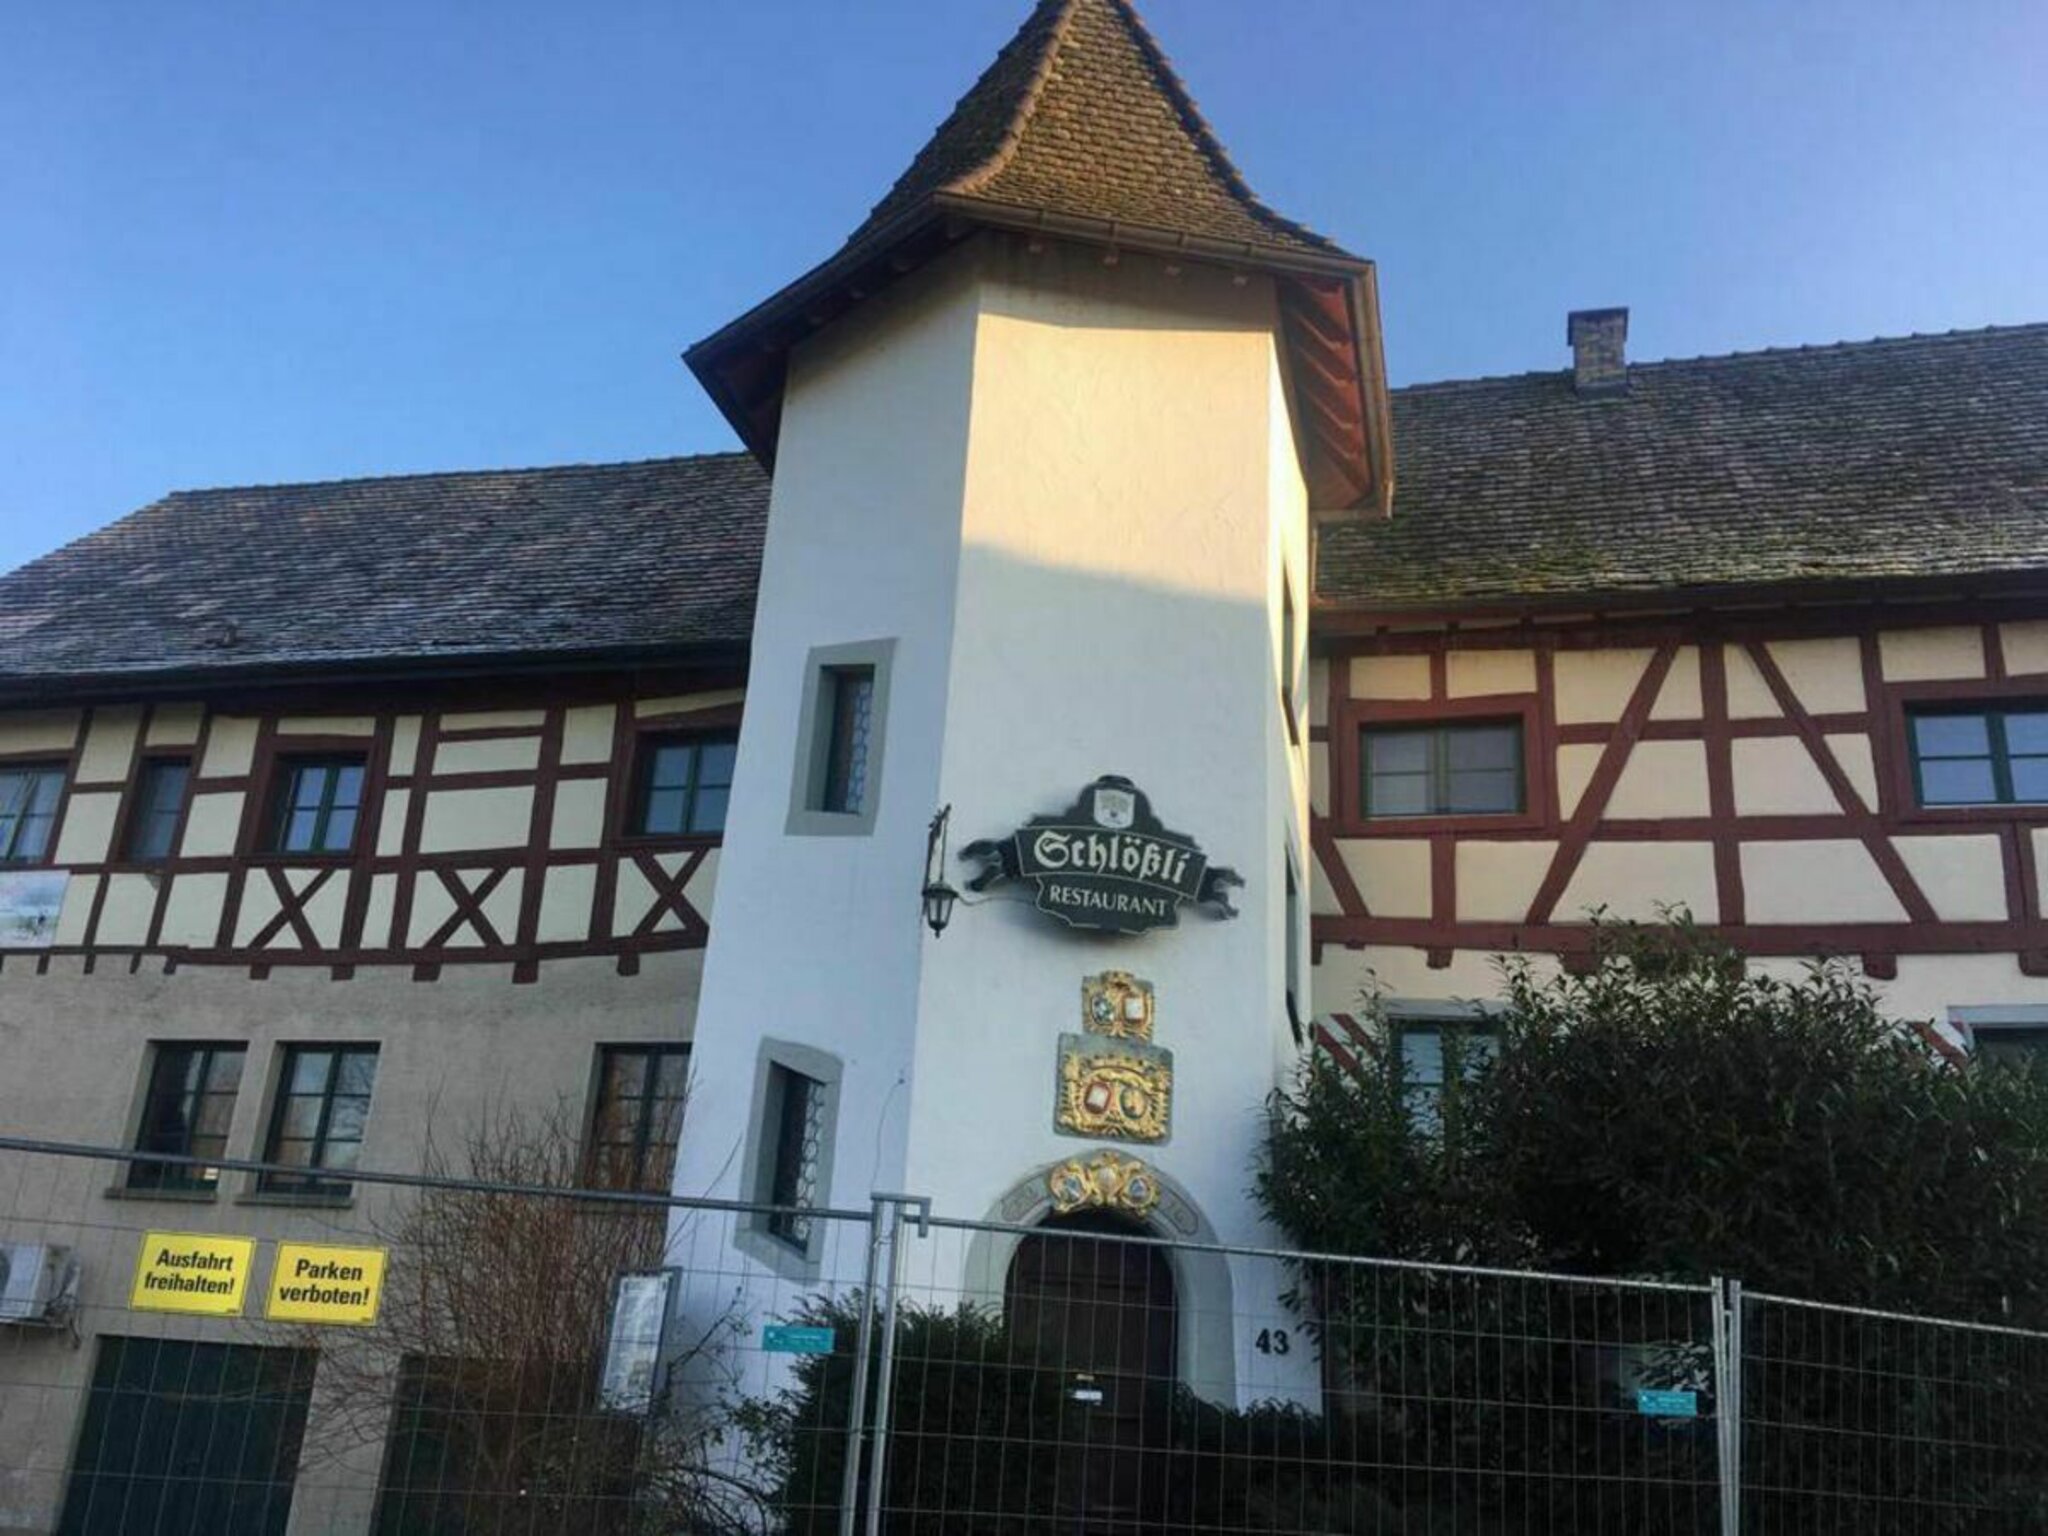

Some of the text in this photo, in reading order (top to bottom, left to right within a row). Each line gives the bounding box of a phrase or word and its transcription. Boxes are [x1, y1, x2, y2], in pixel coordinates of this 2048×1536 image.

[1033, 829, 1191, 884] Schlößli
[1049, 885, 1167, 917] RESTAURANT
[156, 1249, 234, 1271] Ausfahrt
[295, 1258, 363, 1281] Parken
[144, 1271, 235, 1295] freihalten!
[279, 1285, 370, 1307] verboten!
[1255, 1328, 1290, 1355] 43
